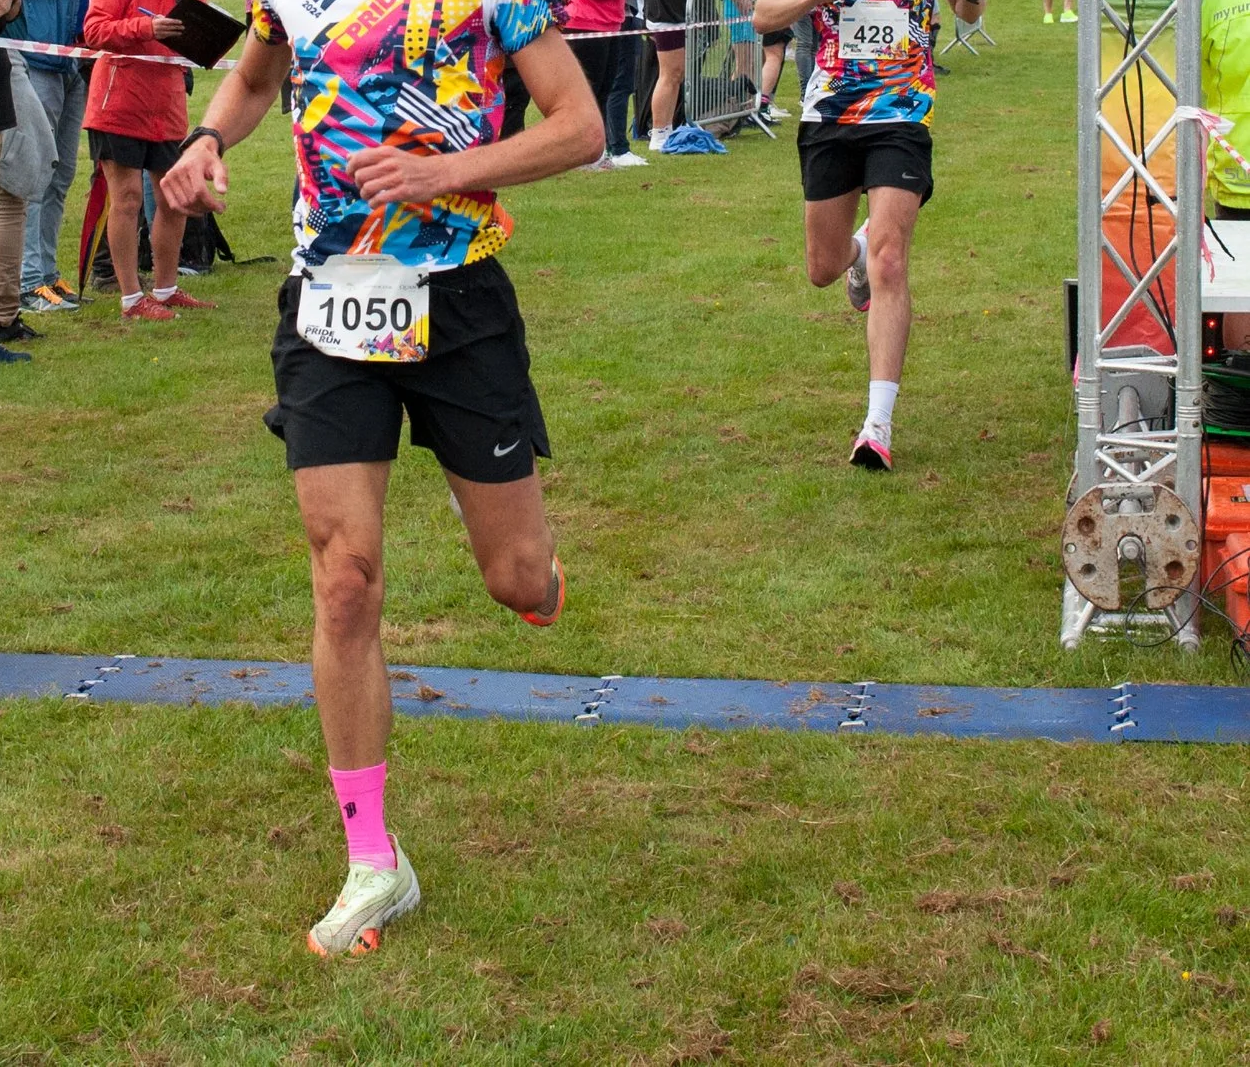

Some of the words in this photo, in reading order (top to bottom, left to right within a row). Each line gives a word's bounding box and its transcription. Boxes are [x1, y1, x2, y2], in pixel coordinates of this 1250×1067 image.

[302, 0, 322, 19] 2024
[854, 25, 894, 44] 428
[302, 133, 344, 217] DUBLIN
[319, 297, 412, 332] 1050
[305, 326, 335, 337] PRIDE
[318, 335, 341, 345] RUN
